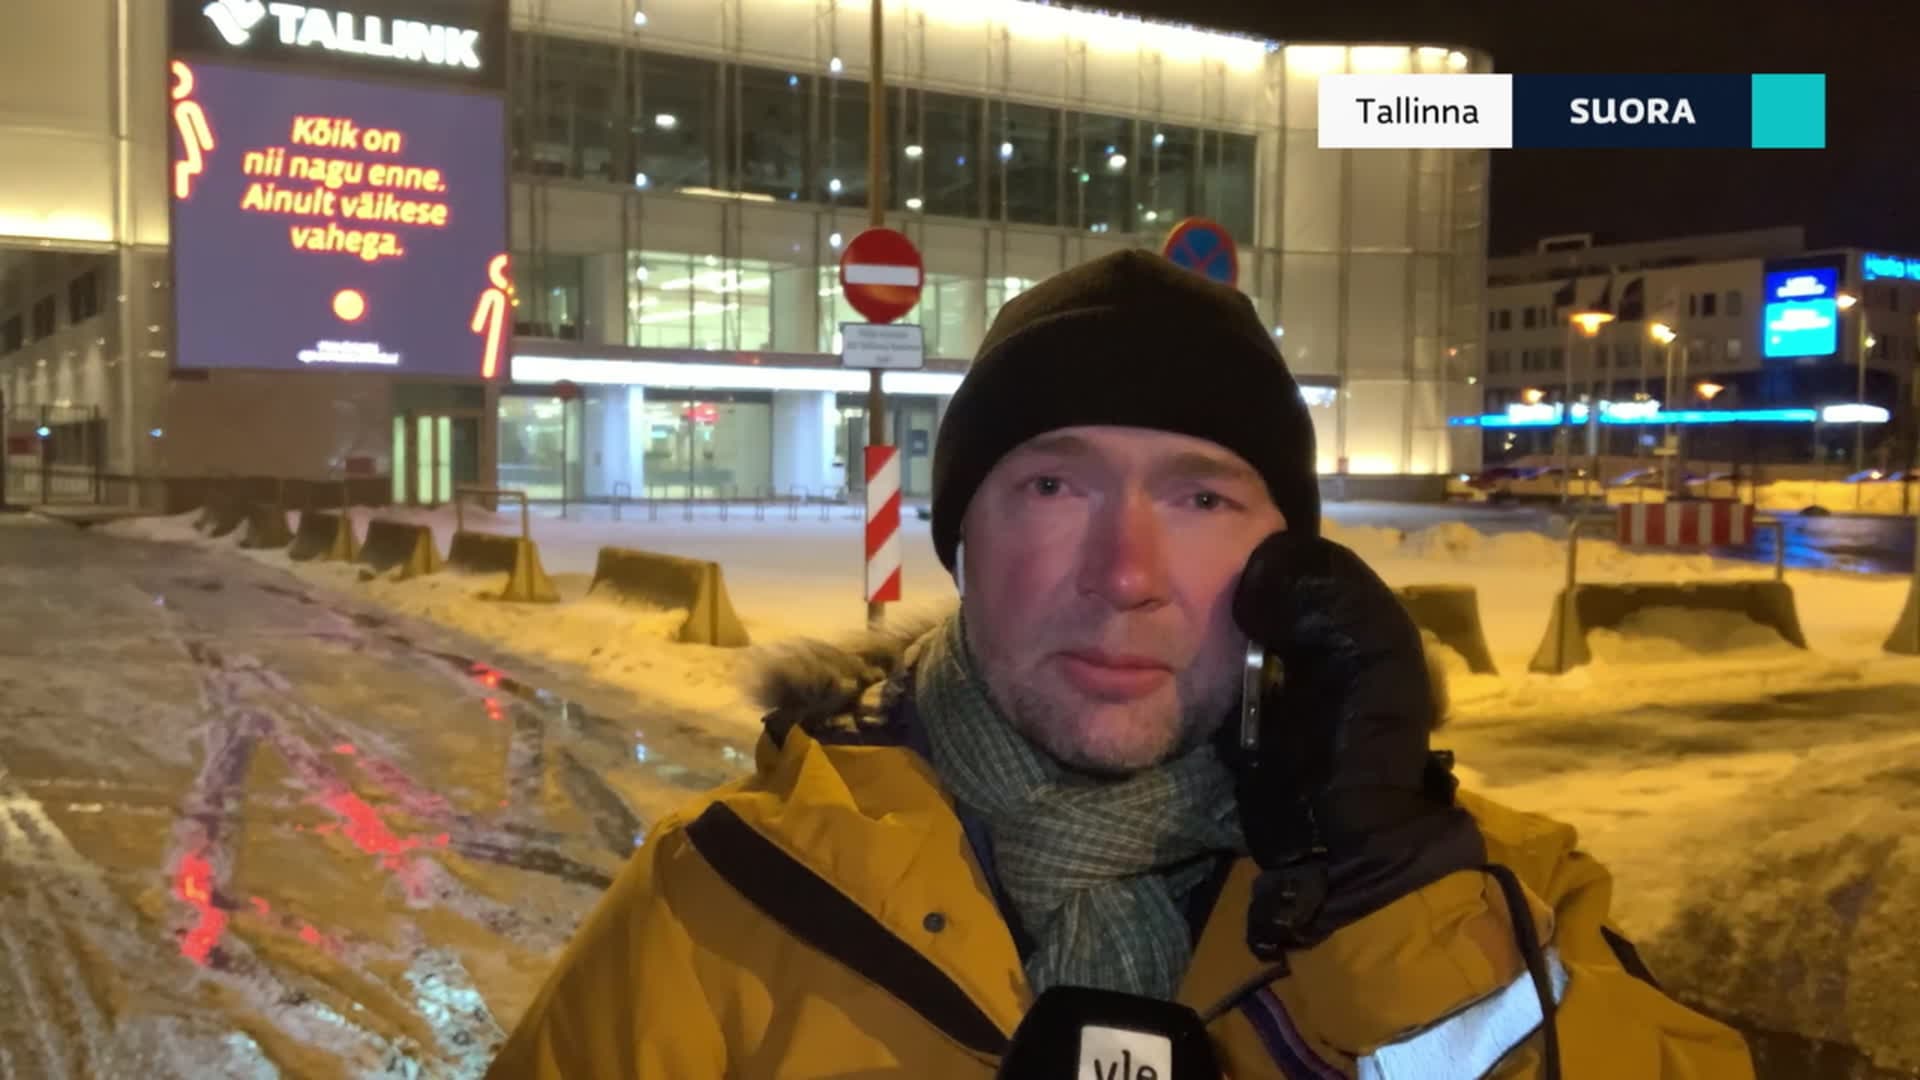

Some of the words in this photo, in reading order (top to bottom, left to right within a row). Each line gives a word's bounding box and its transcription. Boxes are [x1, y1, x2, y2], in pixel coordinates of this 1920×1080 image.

[268, 2, 481, 69] TALLINK
[291, 116, 358, 149] Kõik
[362, 128, 402, 153] on
[243, 148, 286, 177] nii
[288, 155, 363, 189] nagu
[367, 165, 447, 193] enne.
[242, 182, 335, 217] Ainult
[339, 191, 448, 226] väikese
[289, 222, 404, 262] vahega.
